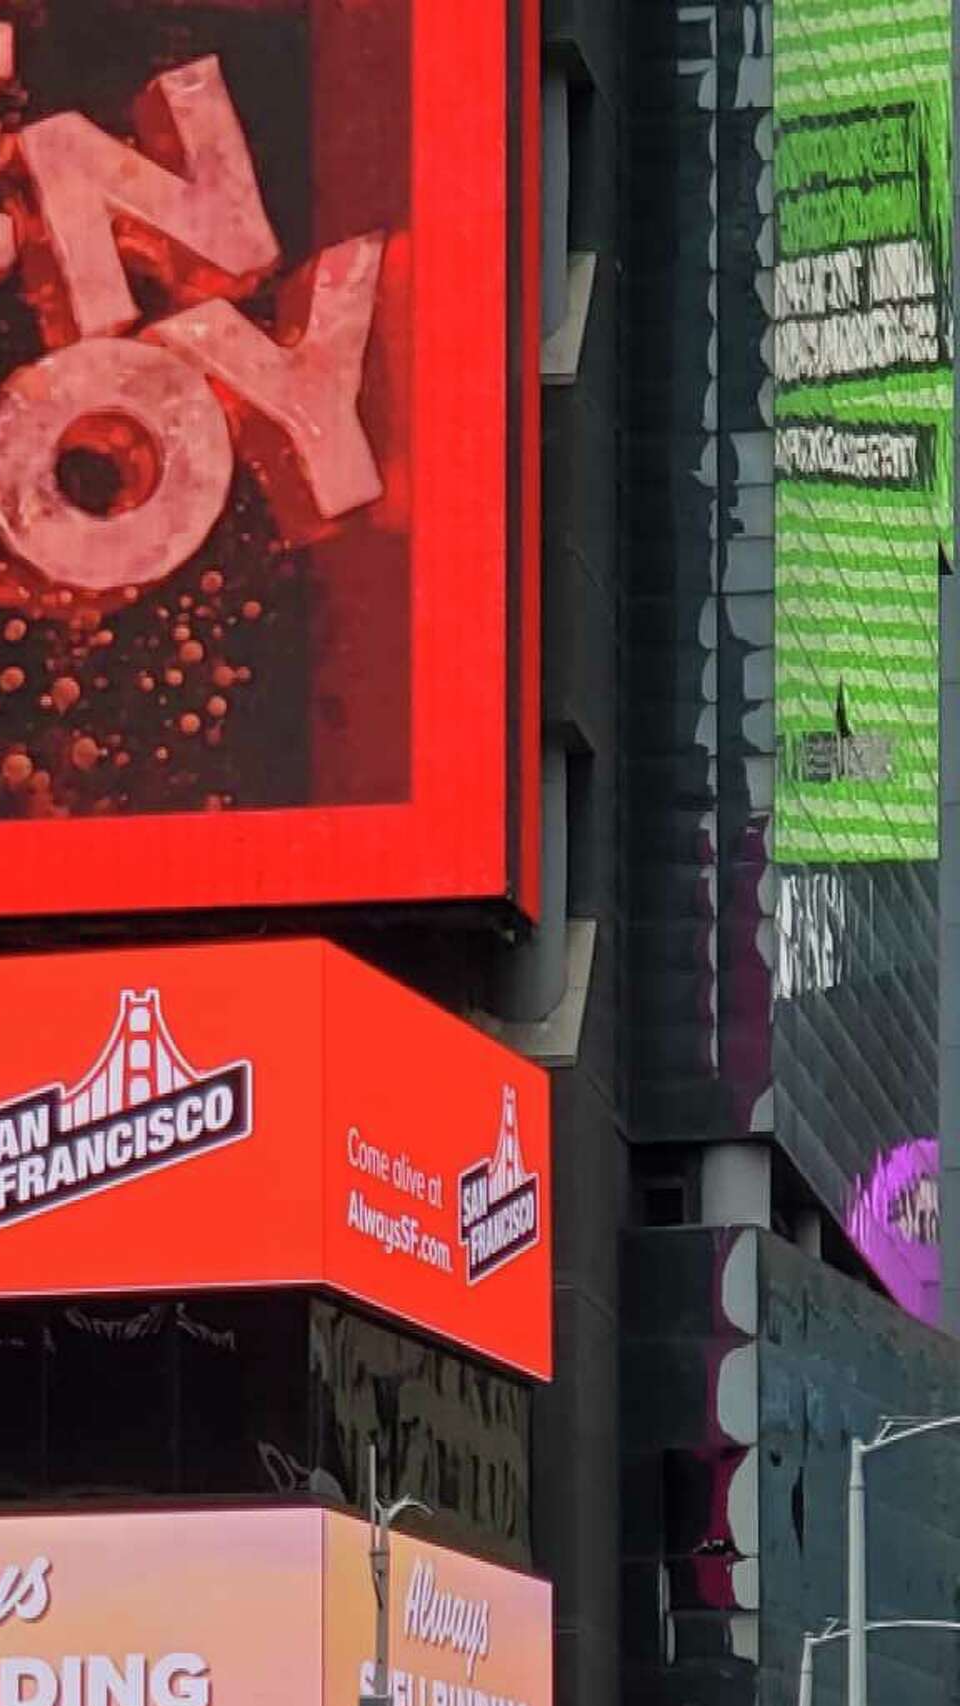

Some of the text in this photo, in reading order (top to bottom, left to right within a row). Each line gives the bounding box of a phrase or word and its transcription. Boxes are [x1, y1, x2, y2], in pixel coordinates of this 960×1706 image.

[346, 1126, 444, 1210] Come alive at
[461, 1175, 489, 1227] SAN
[469, 1192, 535, 1267] FRANCISCO
[401, 1557, 492, 1680] Always
